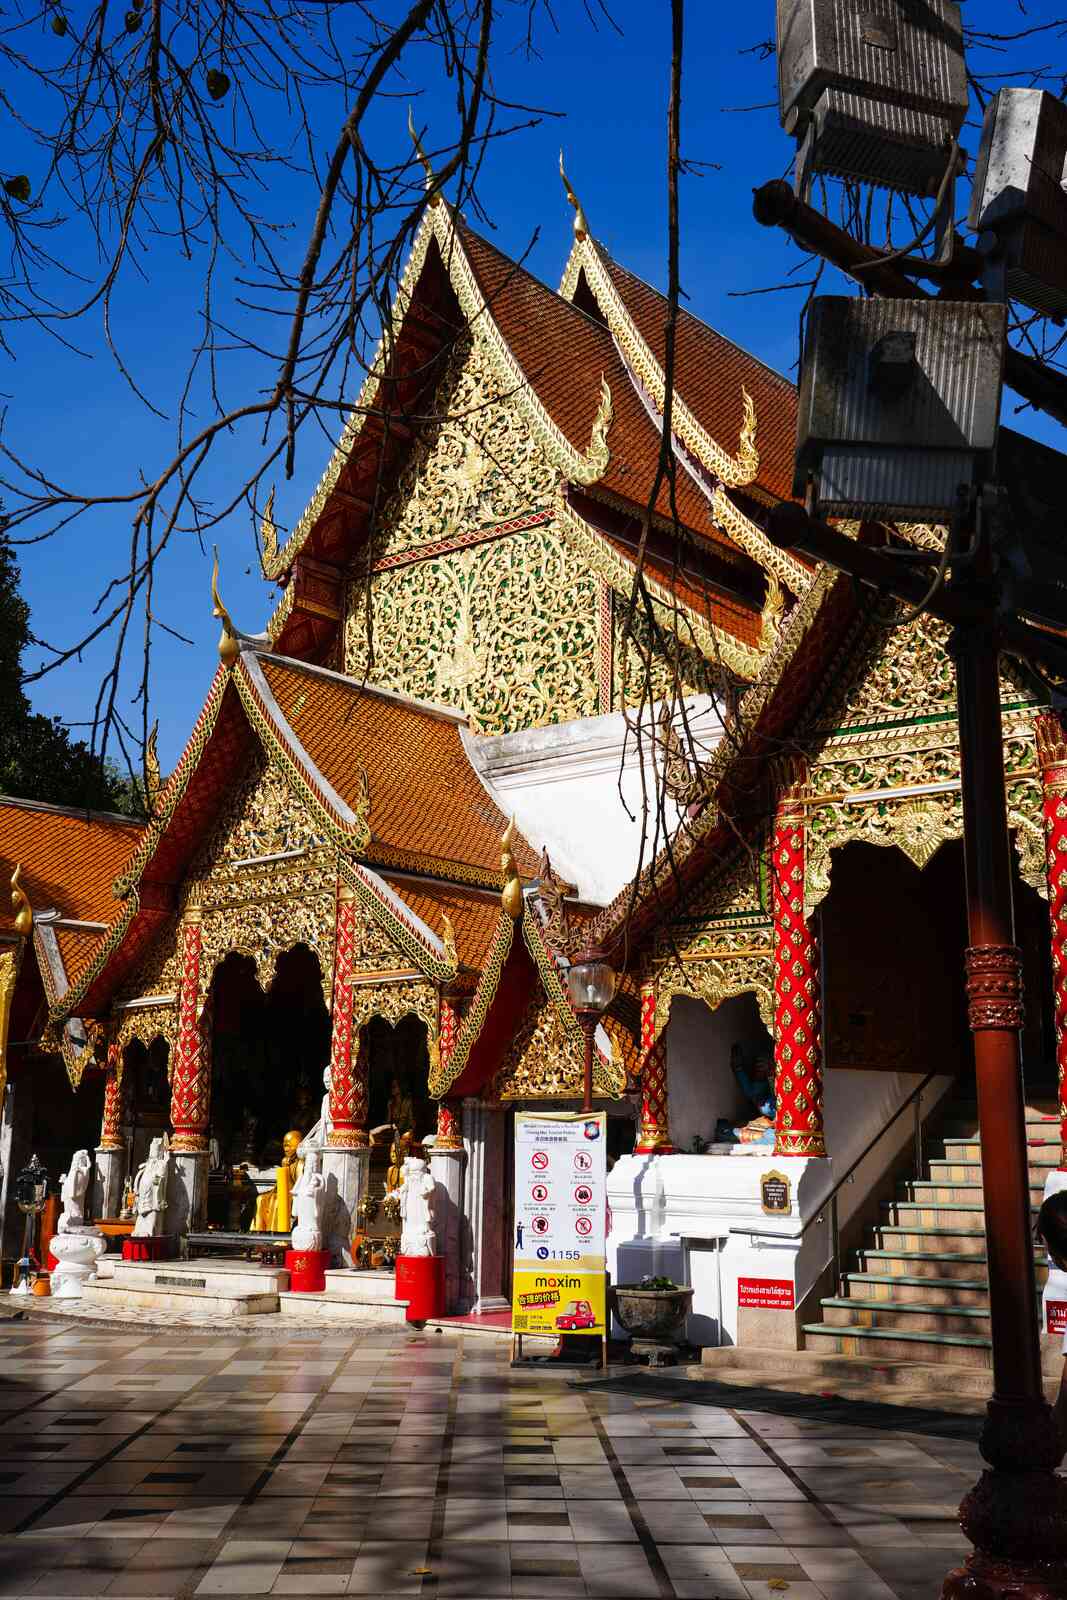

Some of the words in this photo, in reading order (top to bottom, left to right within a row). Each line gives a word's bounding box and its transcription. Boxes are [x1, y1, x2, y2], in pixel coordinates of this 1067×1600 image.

[551, 1250, 580, 1260] 1155
[535, 1275, 581, 1288] maxim
[518, 1291, 560, 1305] 合理的价格
